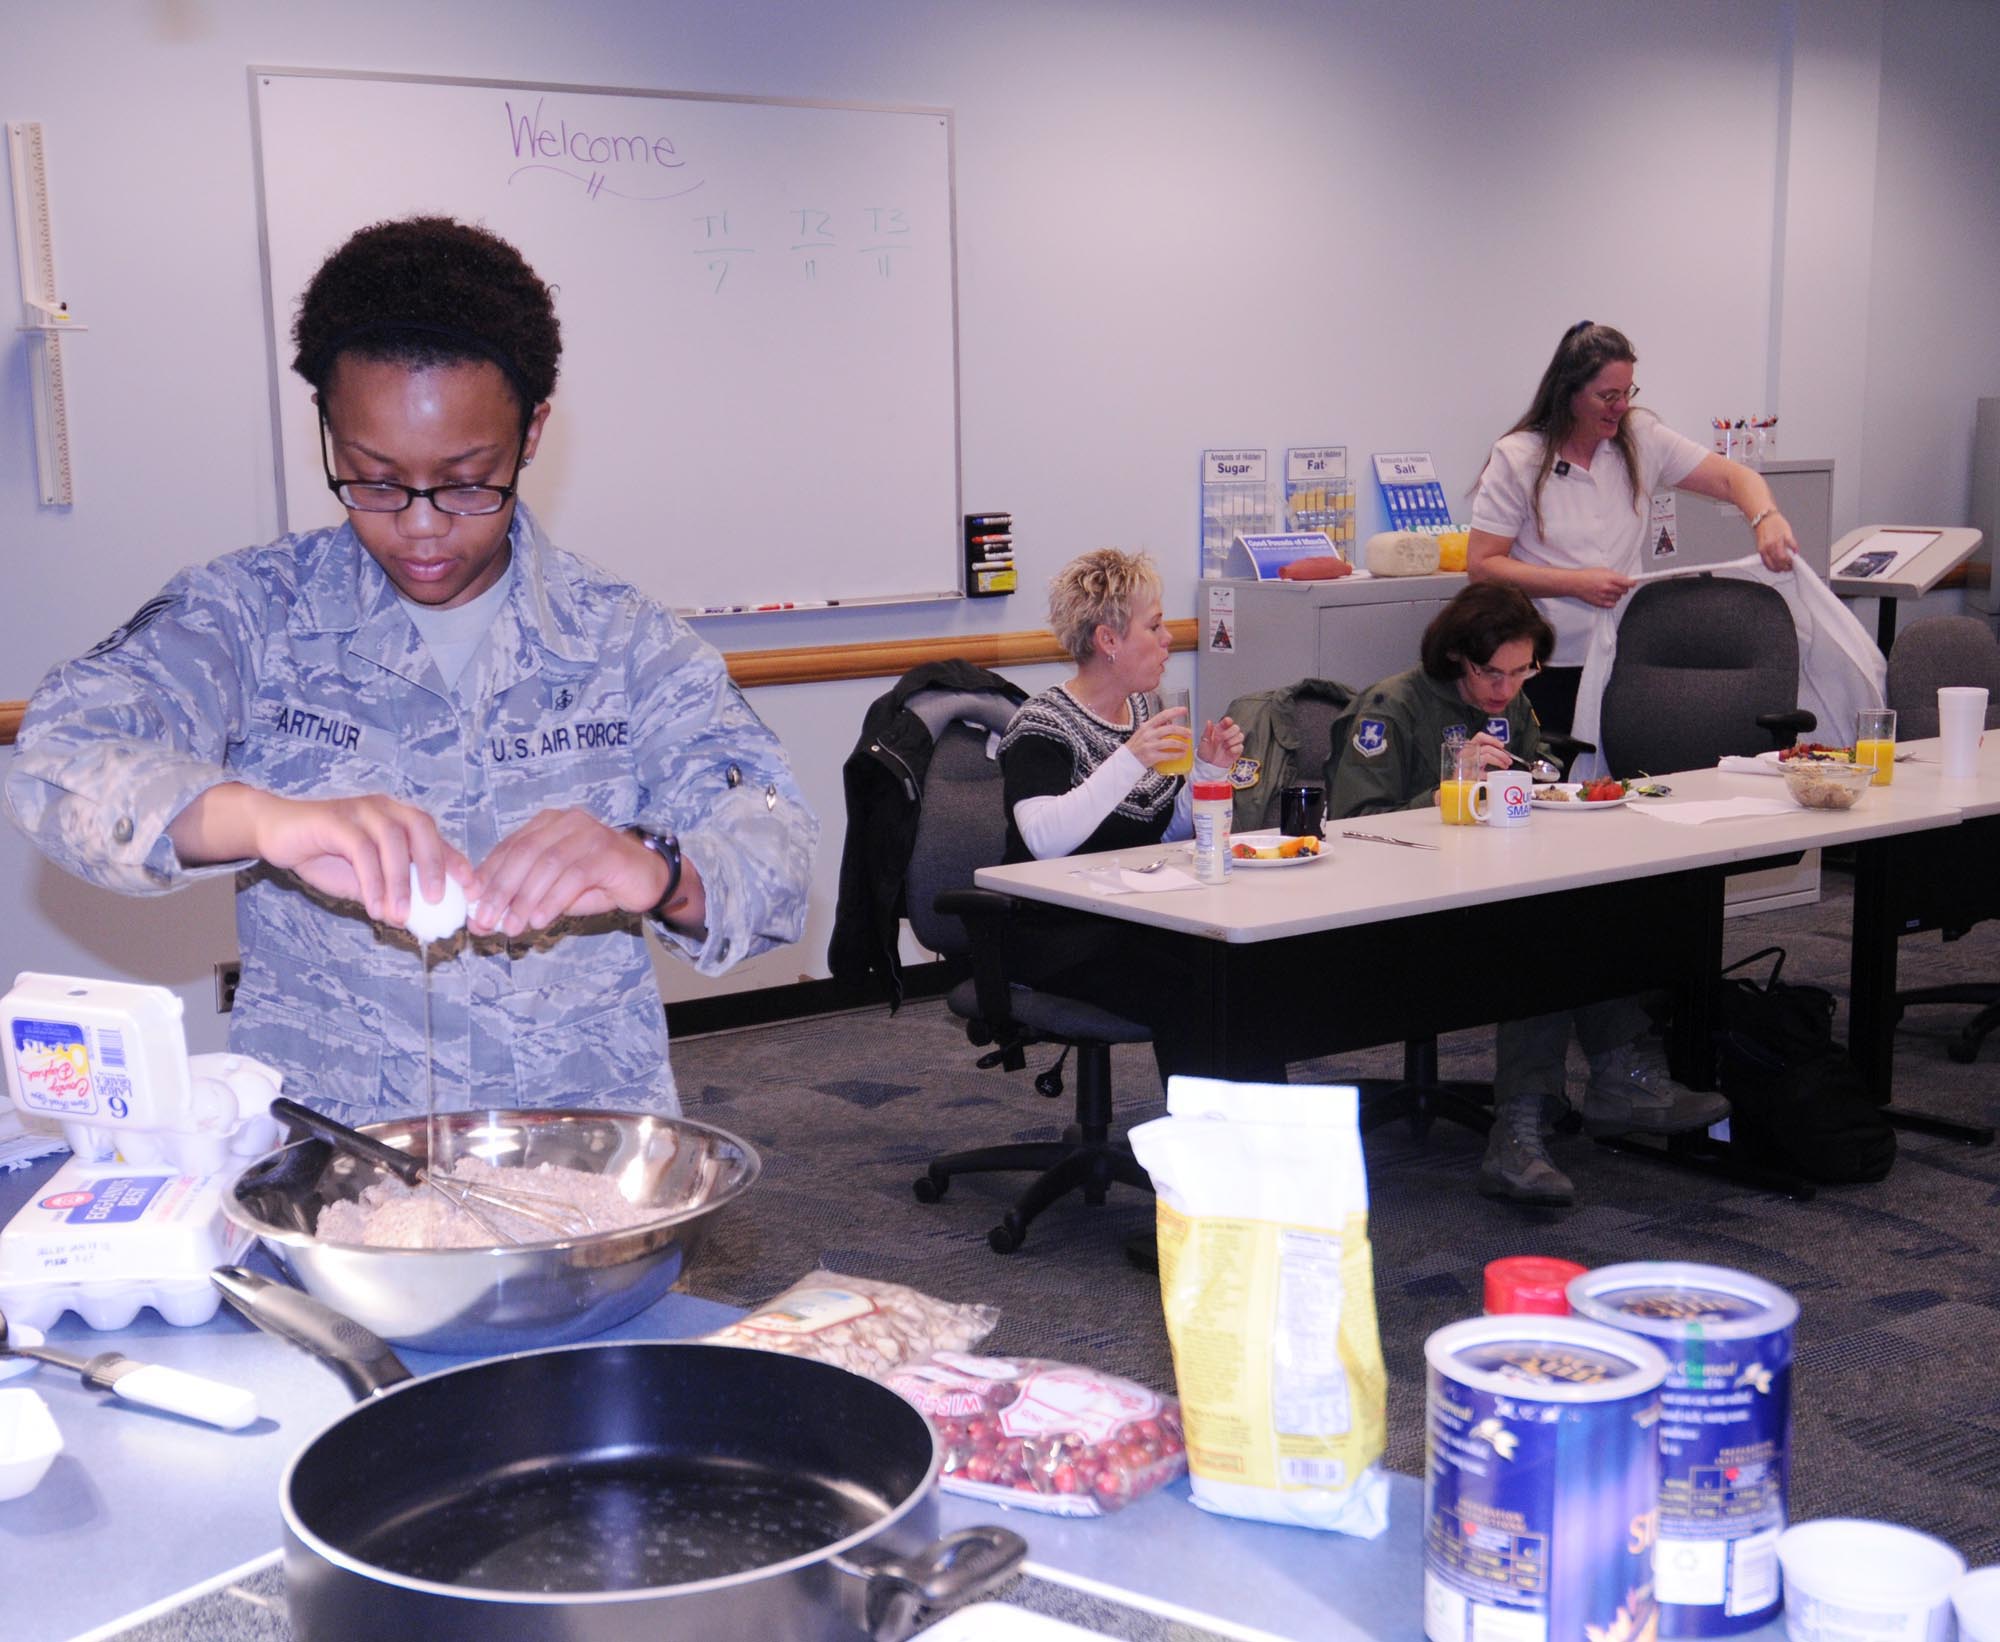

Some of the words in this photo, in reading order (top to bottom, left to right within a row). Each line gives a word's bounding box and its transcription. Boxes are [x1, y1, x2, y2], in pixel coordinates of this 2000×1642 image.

[505, 97, 686, 168] Welcome
[790, 208, 835, 237] T2
[863, 208, 910, 234] T3
[1217, 463, 1250, 475] Sugar
[1307, 459, 1324, 470] Fat
[1394, 464, 1416, 474] Salt
[276, 707, 360, 751] ARTHUR
[492, 738, 535, 762] U.S.
[541, 727, 571, 756] AIR
[575, 721, 629, 749] FORCE
